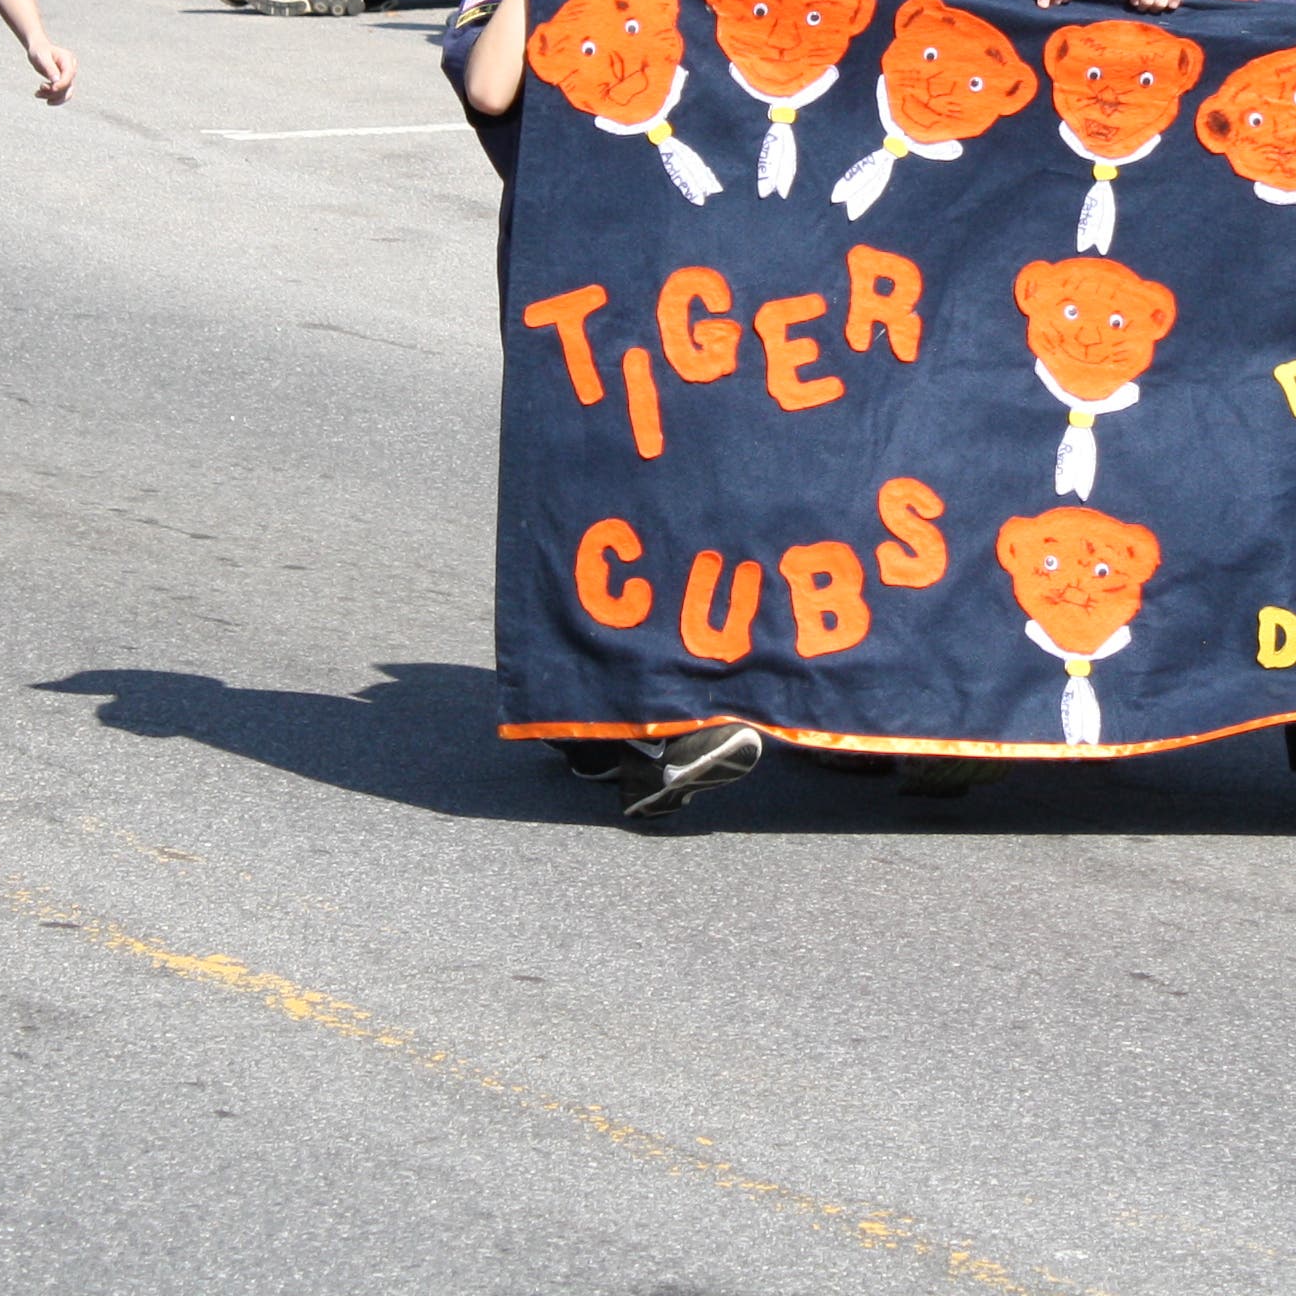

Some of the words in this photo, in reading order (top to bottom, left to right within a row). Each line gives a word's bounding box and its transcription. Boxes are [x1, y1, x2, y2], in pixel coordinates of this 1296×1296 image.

[660, 151, 699, 202] Andrew
[757, 132, 778, 182] Daniel
[523, 244, 924, 461] TIGER
[575, 477, 949, 664] CUBS
